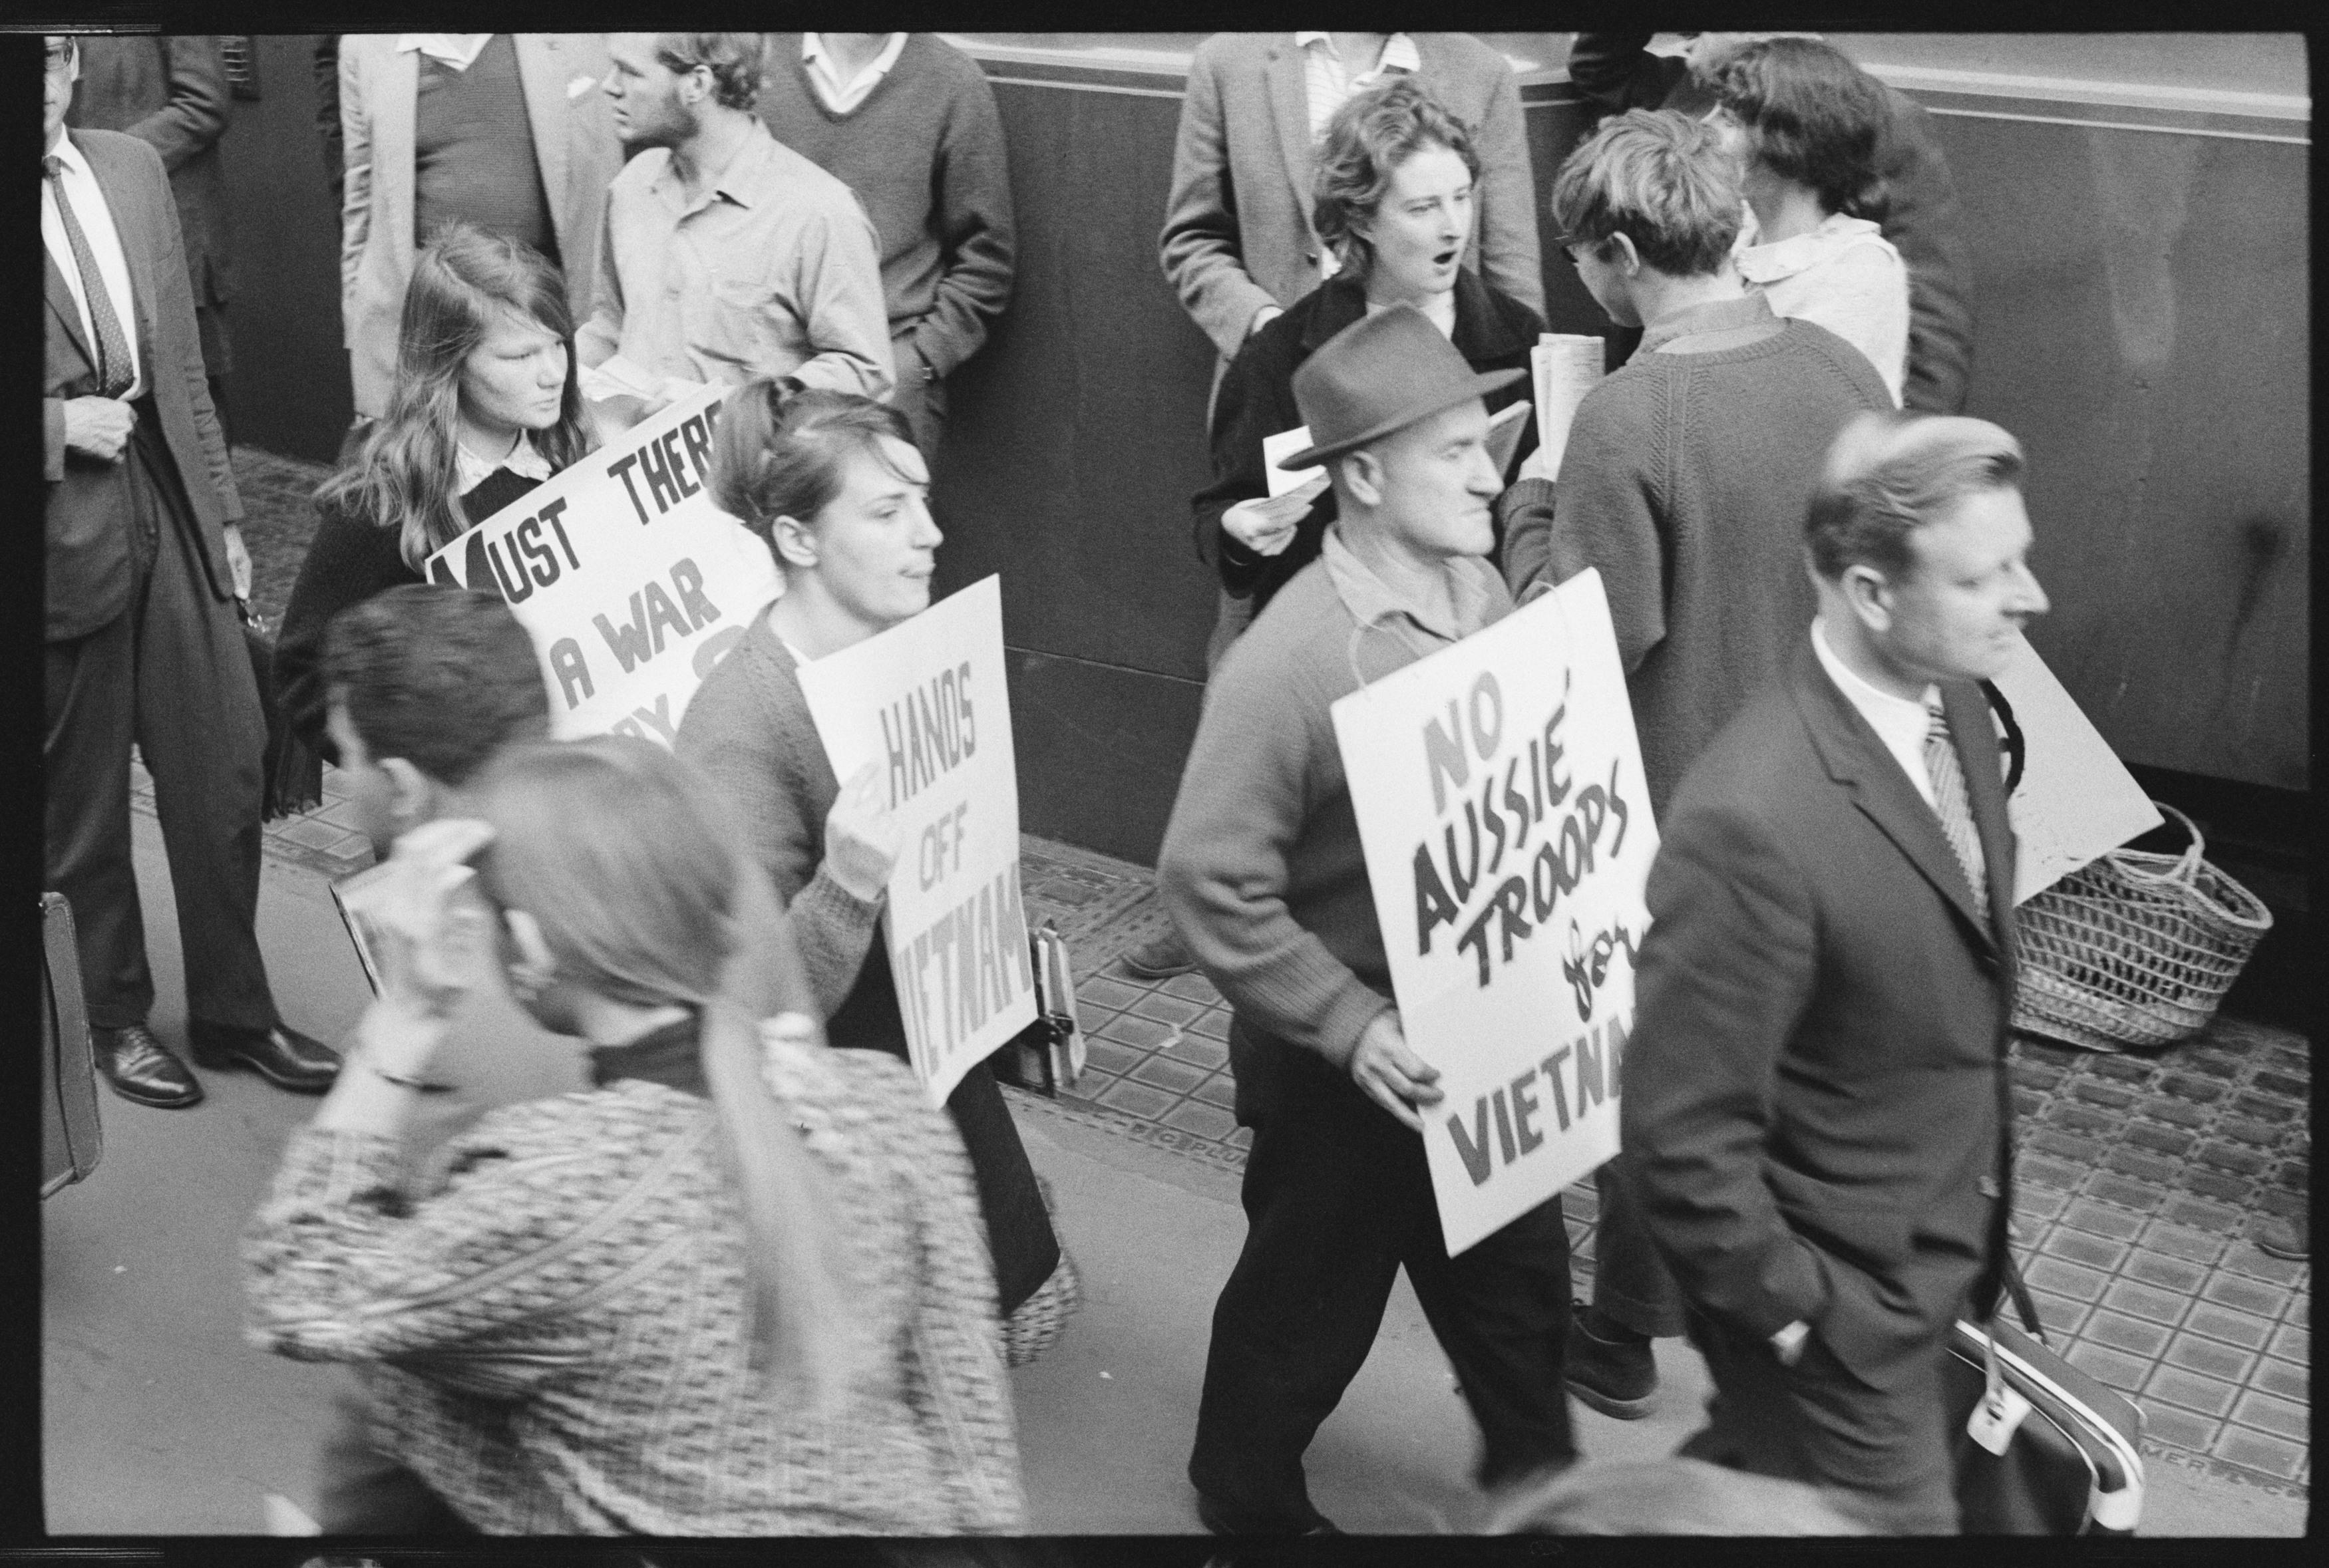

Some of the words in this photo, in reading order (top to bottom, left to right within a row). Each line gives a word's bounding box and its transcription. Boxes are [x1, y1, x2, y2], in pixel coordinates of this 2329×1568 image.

[549, 637, 595, 710] A
[592, 557, 722, 674] WAR
[880, 661, 976, 810] HANDS
[1413, 667, 1572, 956] AUSSIE
[1423, 671, 1503, 818] NO
[918, 801, 968, 893] OFF
[1457, 757, 1628, 989] TROOPS
[898, 862, 1032, 1086] IETNAM
